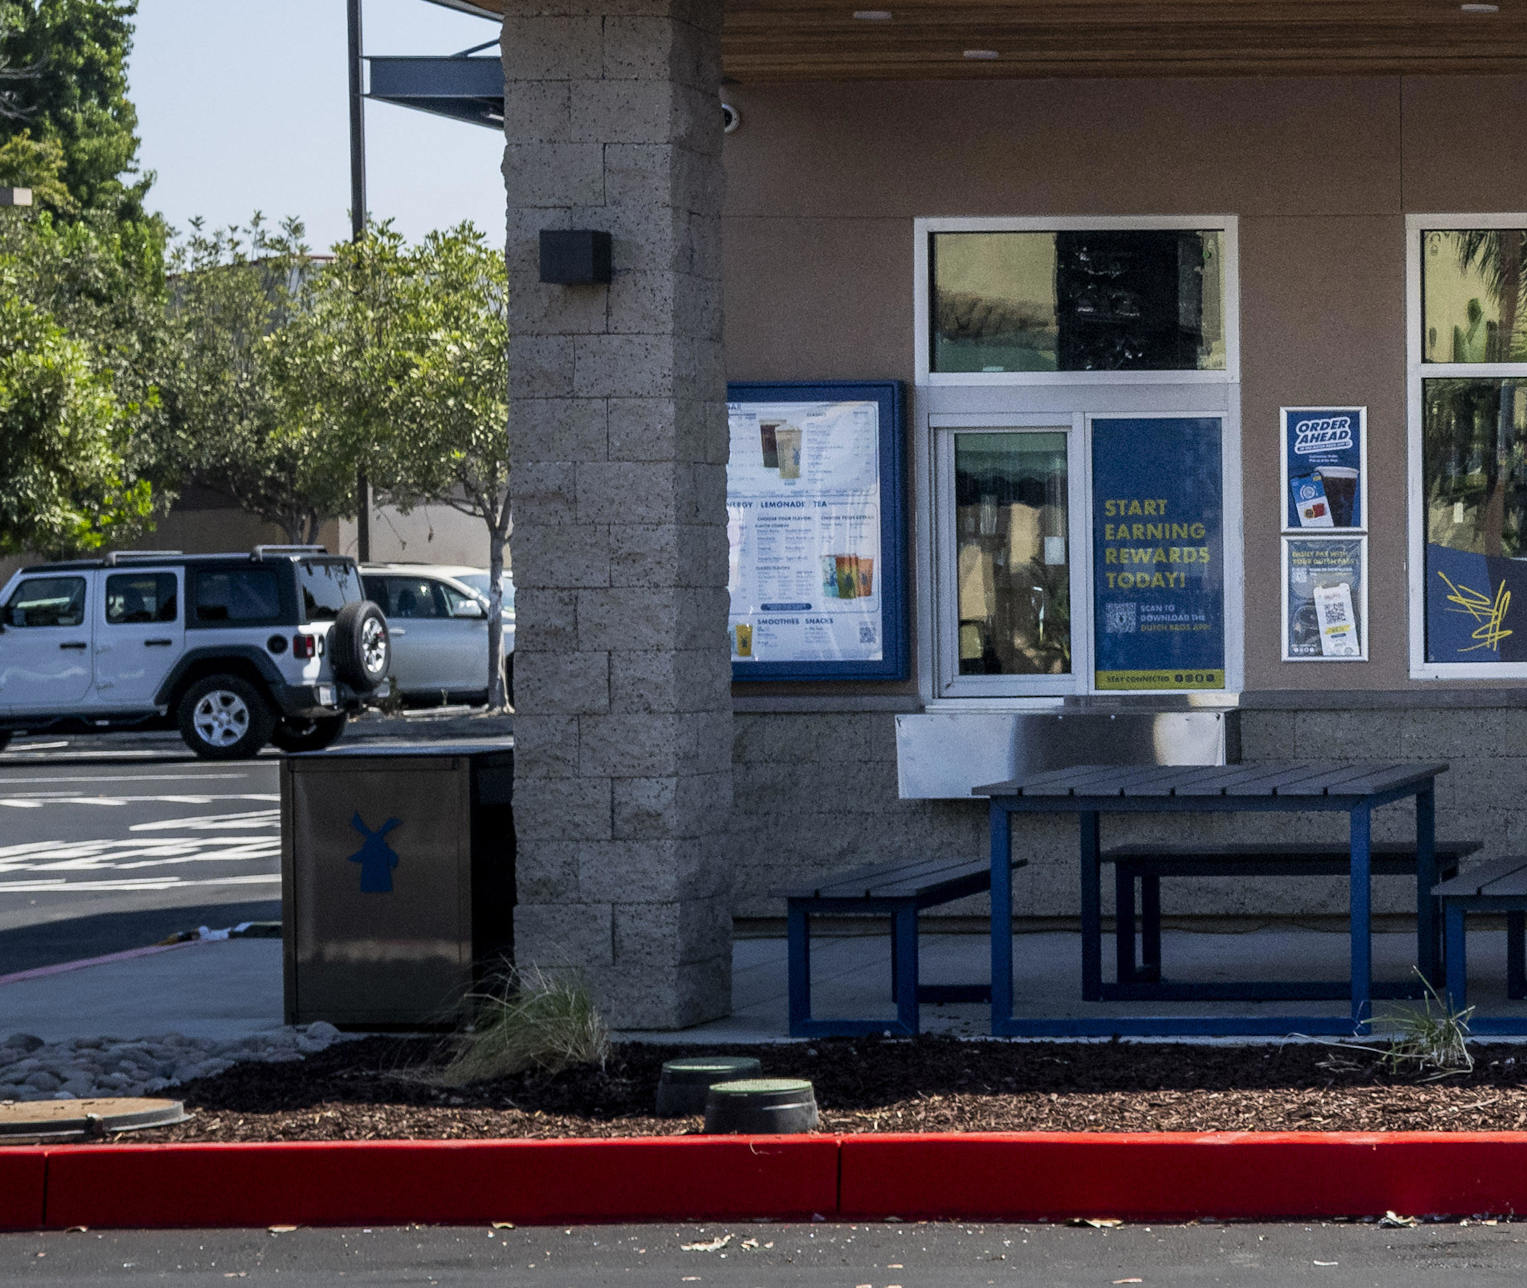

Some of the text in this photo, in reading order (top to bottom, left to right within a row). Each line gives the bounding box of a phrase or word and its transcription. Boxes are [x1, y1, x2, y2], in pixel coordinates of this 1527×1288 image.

[1298, 419, 1349, 433] ORDER
[1298, 430, 1349, 445] AHEAD
[1104, 499, 1168, 516] START
[1104, 523, 1206, 540] EARNING
[1105, 547, 1211, 565] REWARDS
[1105, 571, 1186, 588] TODAY!
[1165, 604, 1175, 612] TO
[1141, 614, 1190, 622] DOWNLOAD
